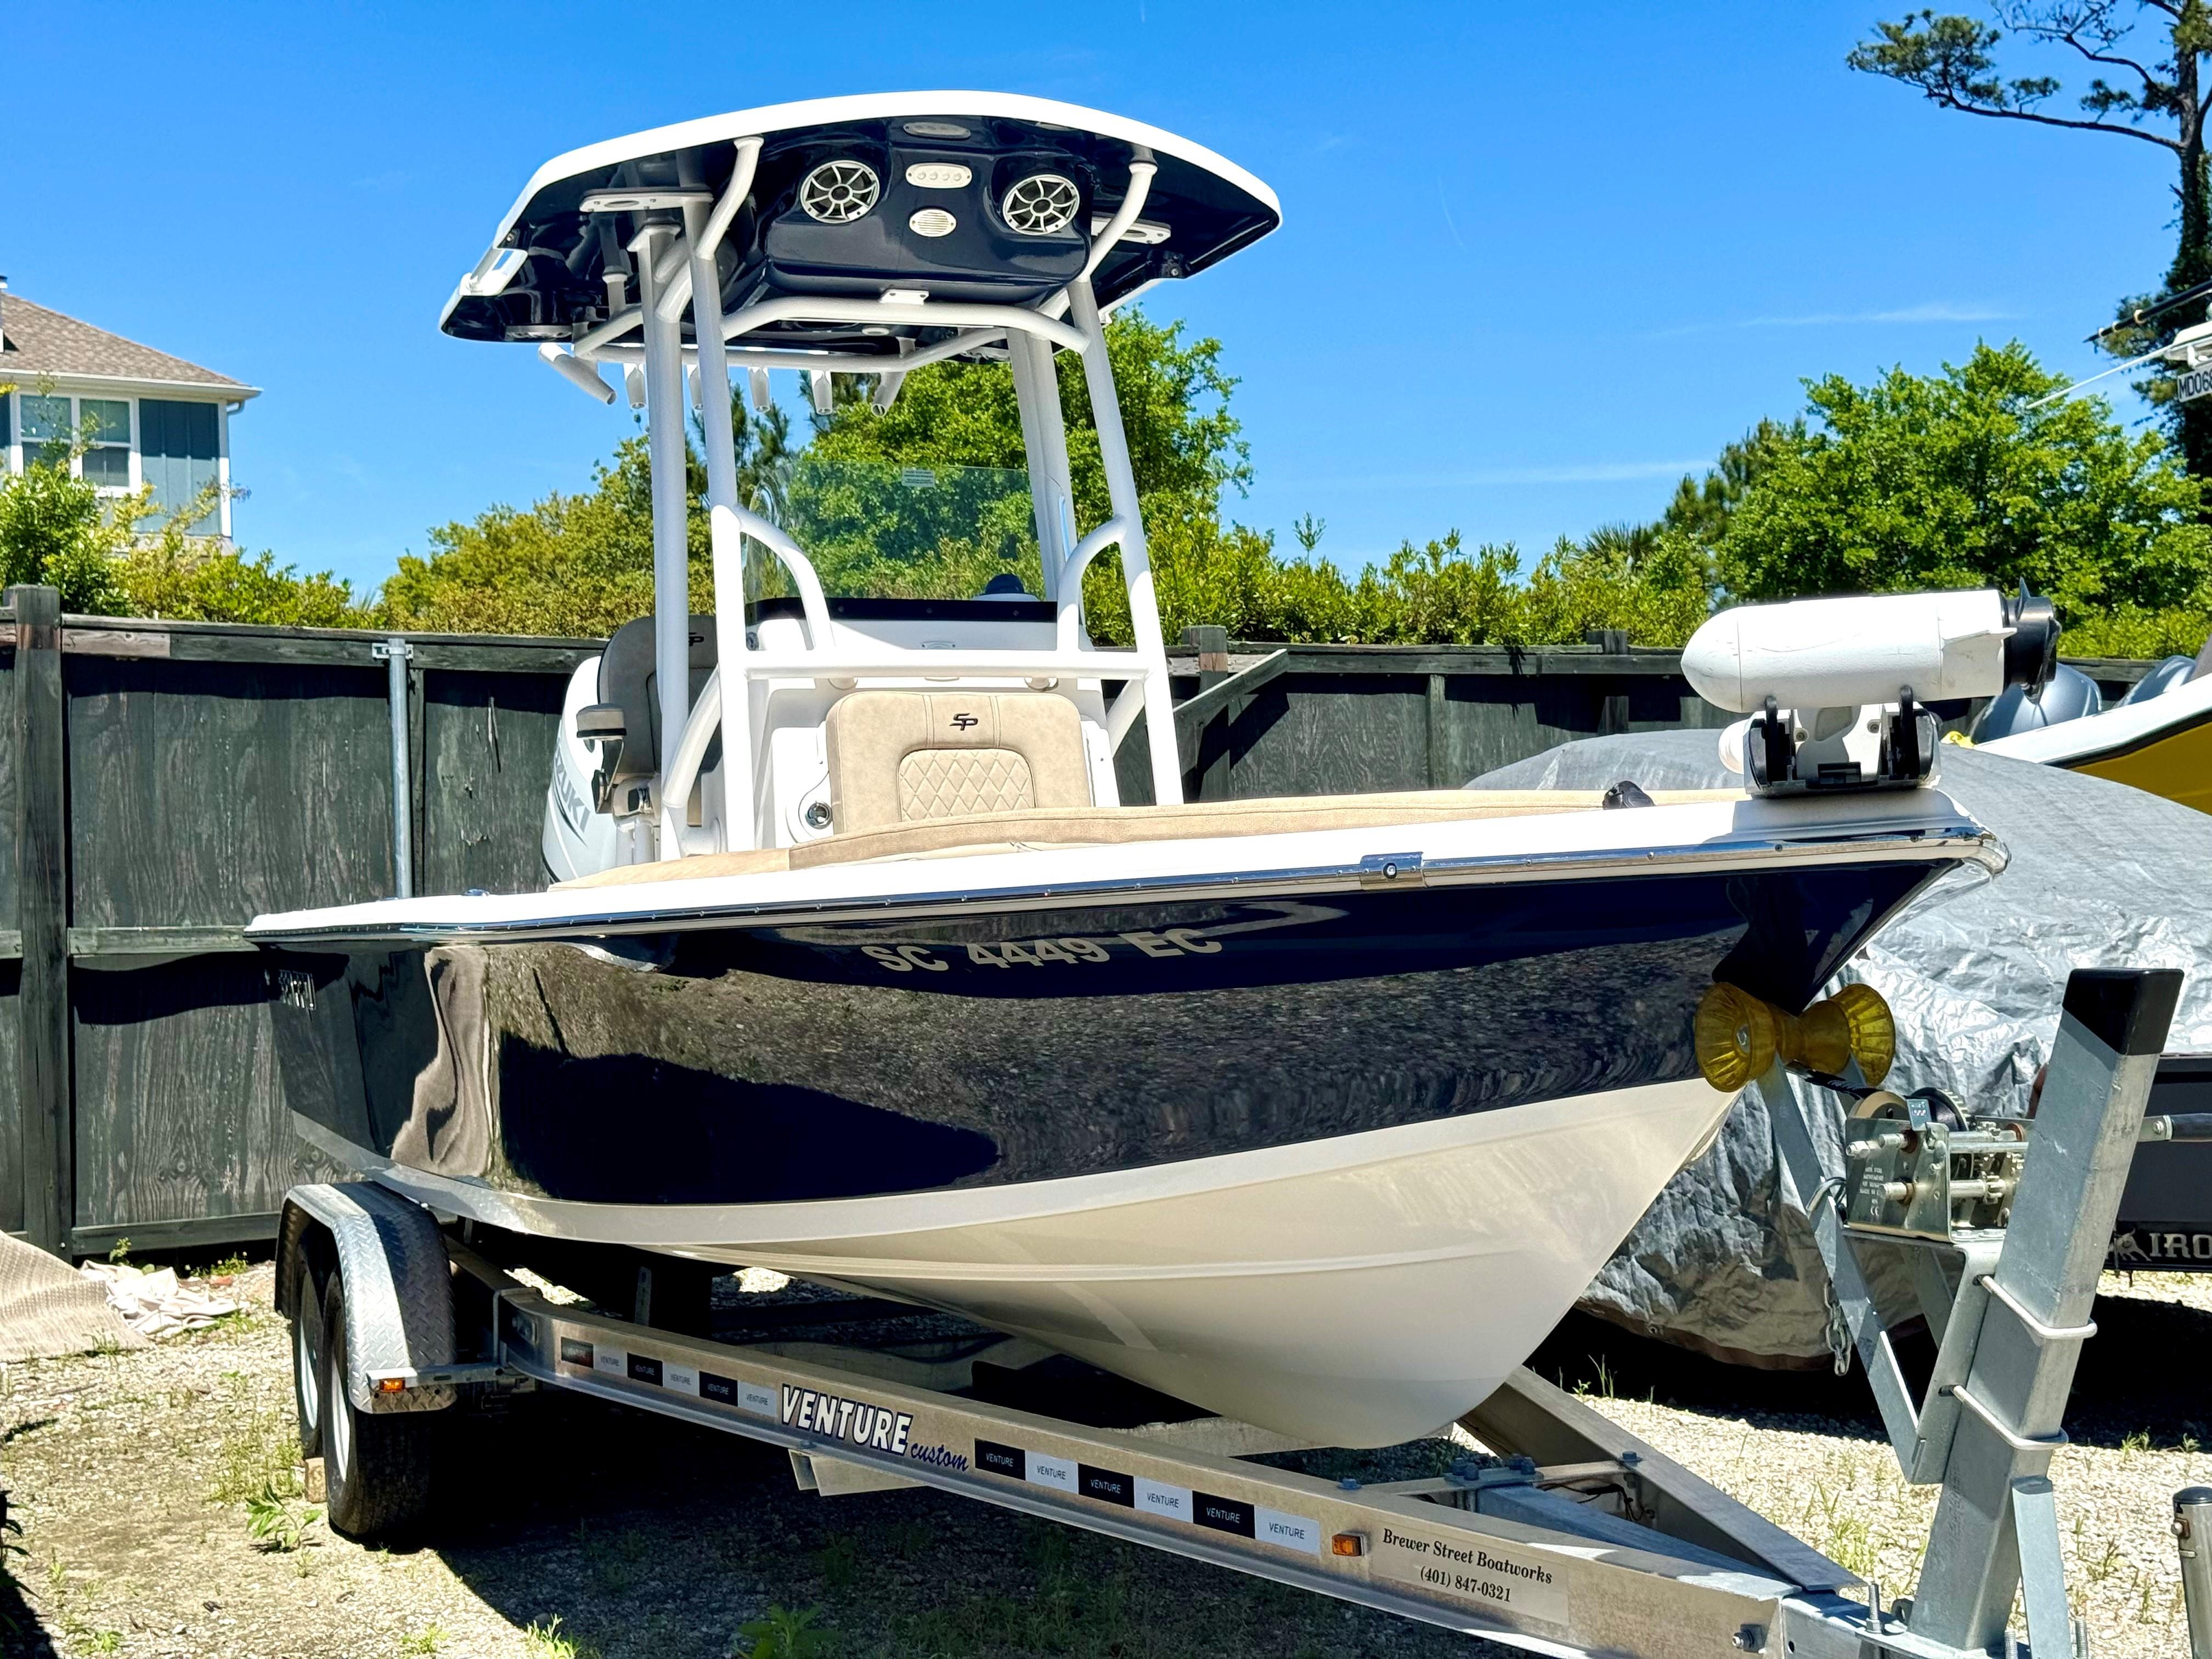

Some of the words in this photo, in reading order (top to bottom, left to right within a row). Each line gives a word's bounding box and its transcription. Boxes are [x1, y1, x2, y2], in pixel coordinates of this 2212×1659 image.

[861, 945, 949, 972] SC
[966, 938, 1110, 968] 4449
[1118, 928, 1223, 957] EC
[2149, 1233, 2212, 1259] IRO
[782, 1383, 913, 1456] VENTURE
[911, 1443, 969, 1472] custom
[986, 1452, 1014, 1468] VENTURE
[1036, 1465, 1066, 1481] VENTURE
[1090, 1479, 1121, 1495] VENTURE
[1147, 1492, 1180, 1509] VENTURE
[1206, 1507, 1240, 1524] VENTURE
[1268, 1522, 1305, 1540] VENTURE
[1383, 1528, 1430, 1553] Brewer
[1433, 1541, 1473, 1565] Street
[1476, 1550, 1553, 1584] Boatworks
[1420, 1566, 1452, 1588] (401)
[1455, 1575, 1511, 1603] 847-0321
